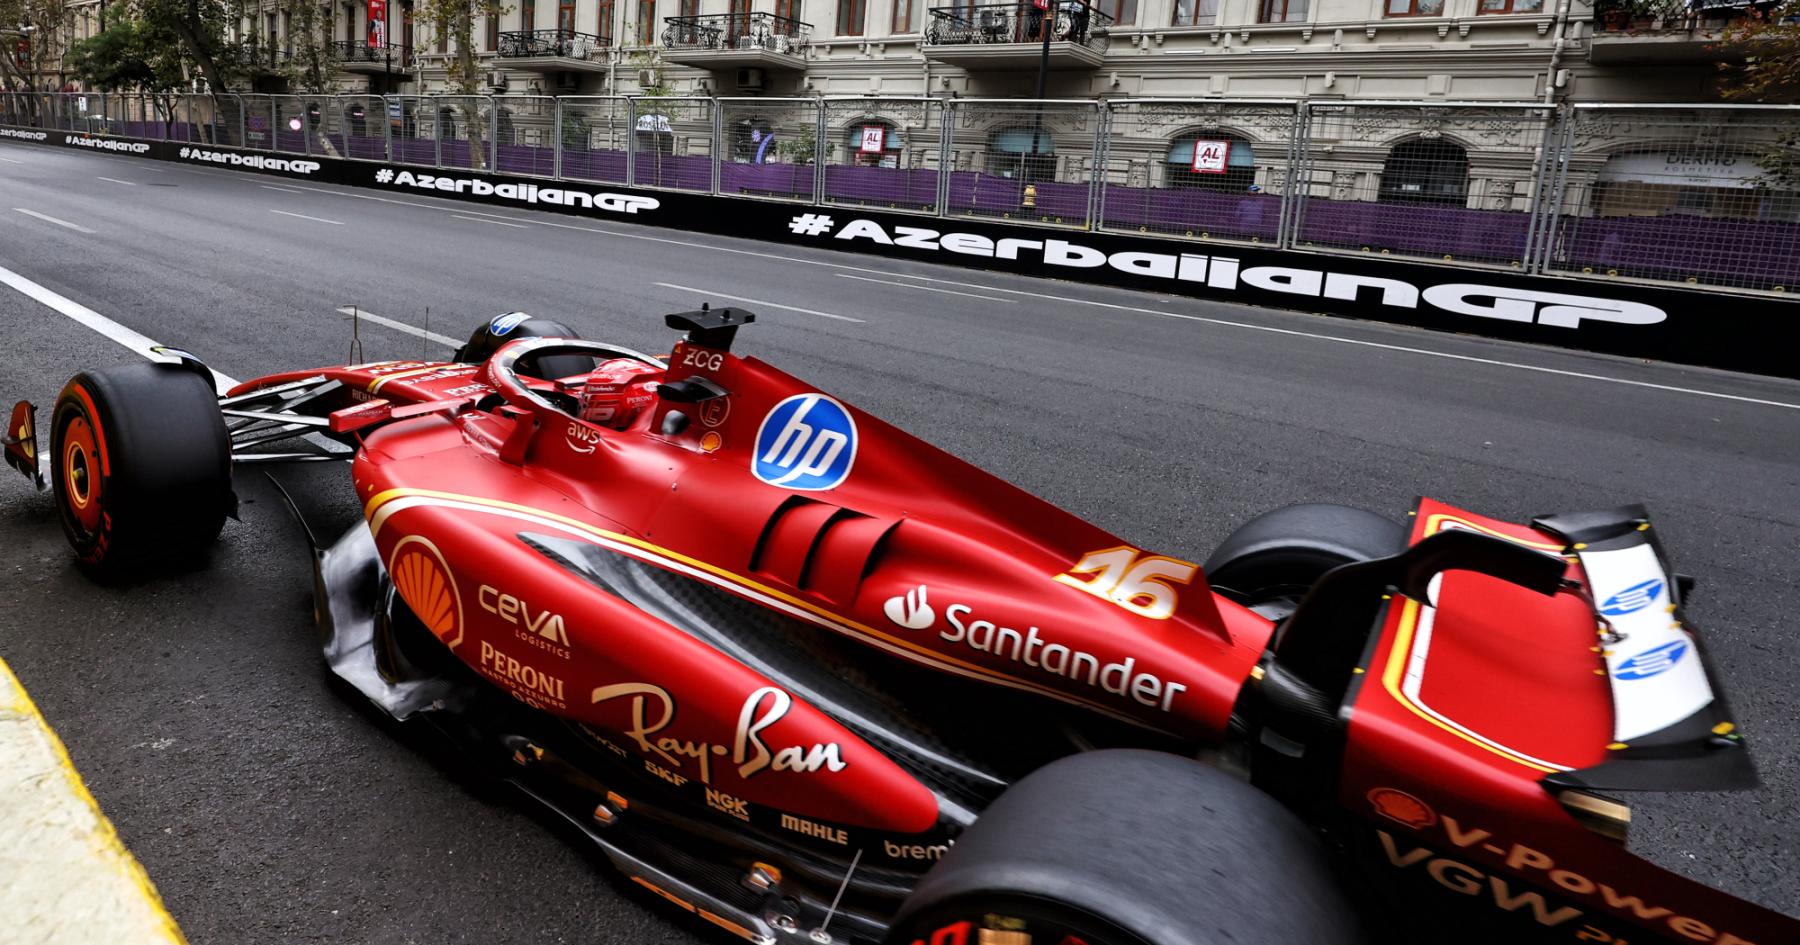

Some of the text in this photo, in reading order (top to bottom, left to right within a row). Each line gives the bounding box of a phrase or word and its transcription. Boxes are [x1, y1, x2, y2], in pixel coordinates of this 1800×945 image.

[65, 135, 150, 154] #AzerbaijanGP
[179, 147, 321, 174] #AzerbaijanGP
[1201, 147, 1220, 160] AL
[375, 168, 661, 214] #AzerbaijanGP
[788, 213, 1668, 329] #AzerbaijanGP
[683, 347, 724, 371] ZCG
[567, 421, 600, 445] aws
[757, 394, 851, 488] hp
[1052, 545, 1201, 620] 16
[515, 628, 571, 660] LOGISTICS
[939, 603, 1187, 712] Santander
[480, 639, 565, 701] PERONI
[644, 759, 689, 787] SKF
[705, 787, 749, 816] NGK
[781, 813, 848, 846] MAHLE
[884, 839, 955, 861] brem
[1376, 829, 1585, 928] VGW
